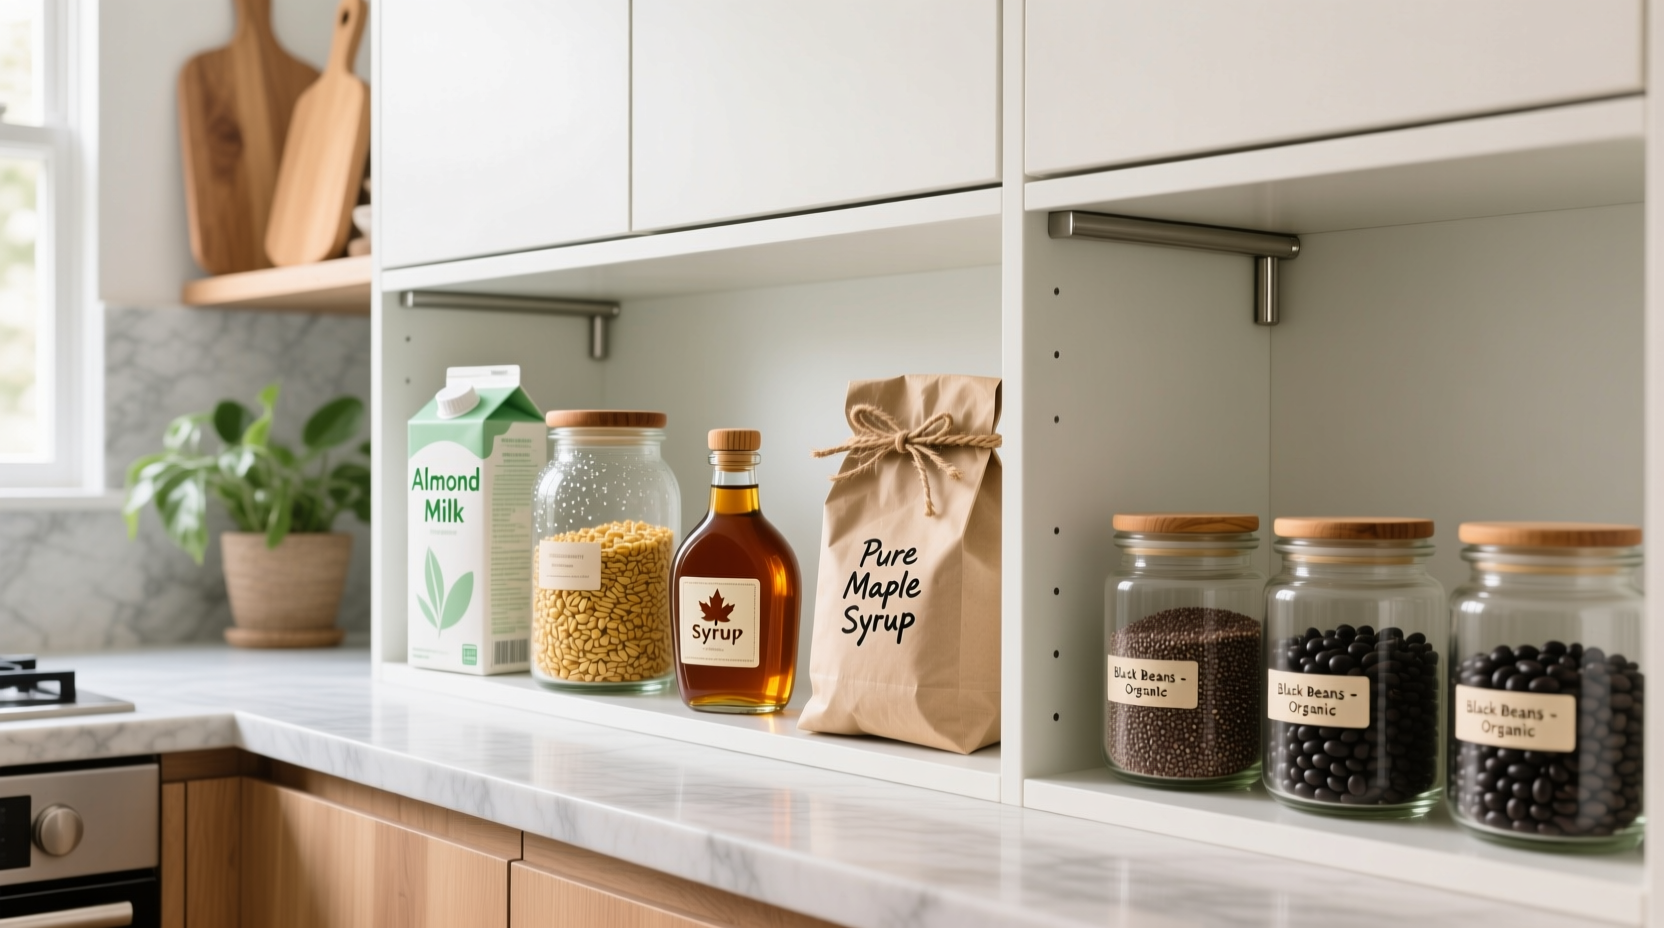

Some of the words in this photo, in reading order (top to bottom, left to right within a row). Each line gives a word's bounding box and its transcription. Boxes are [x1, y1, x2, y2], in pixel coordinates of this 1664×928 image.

[411, 466, 480, 492] Almond
[424, 498, 465, 523] Milk
[859, 538, 918, 568] Pure
[842, 570, 922, 610] Maple
[692, 624, 743, 646] Syrup
[841, 605, 915, 647] Syrup
[1141, 669, 1176, 683] Beans
[1307, 685, 1345, 700] Beans
[1288, 700, 1337, 717] Organic
[1466, 699, 1498, 715] Black
[1501, 704, 1544, 721] Beans
[1481, 719, 1535, 738] Organic
